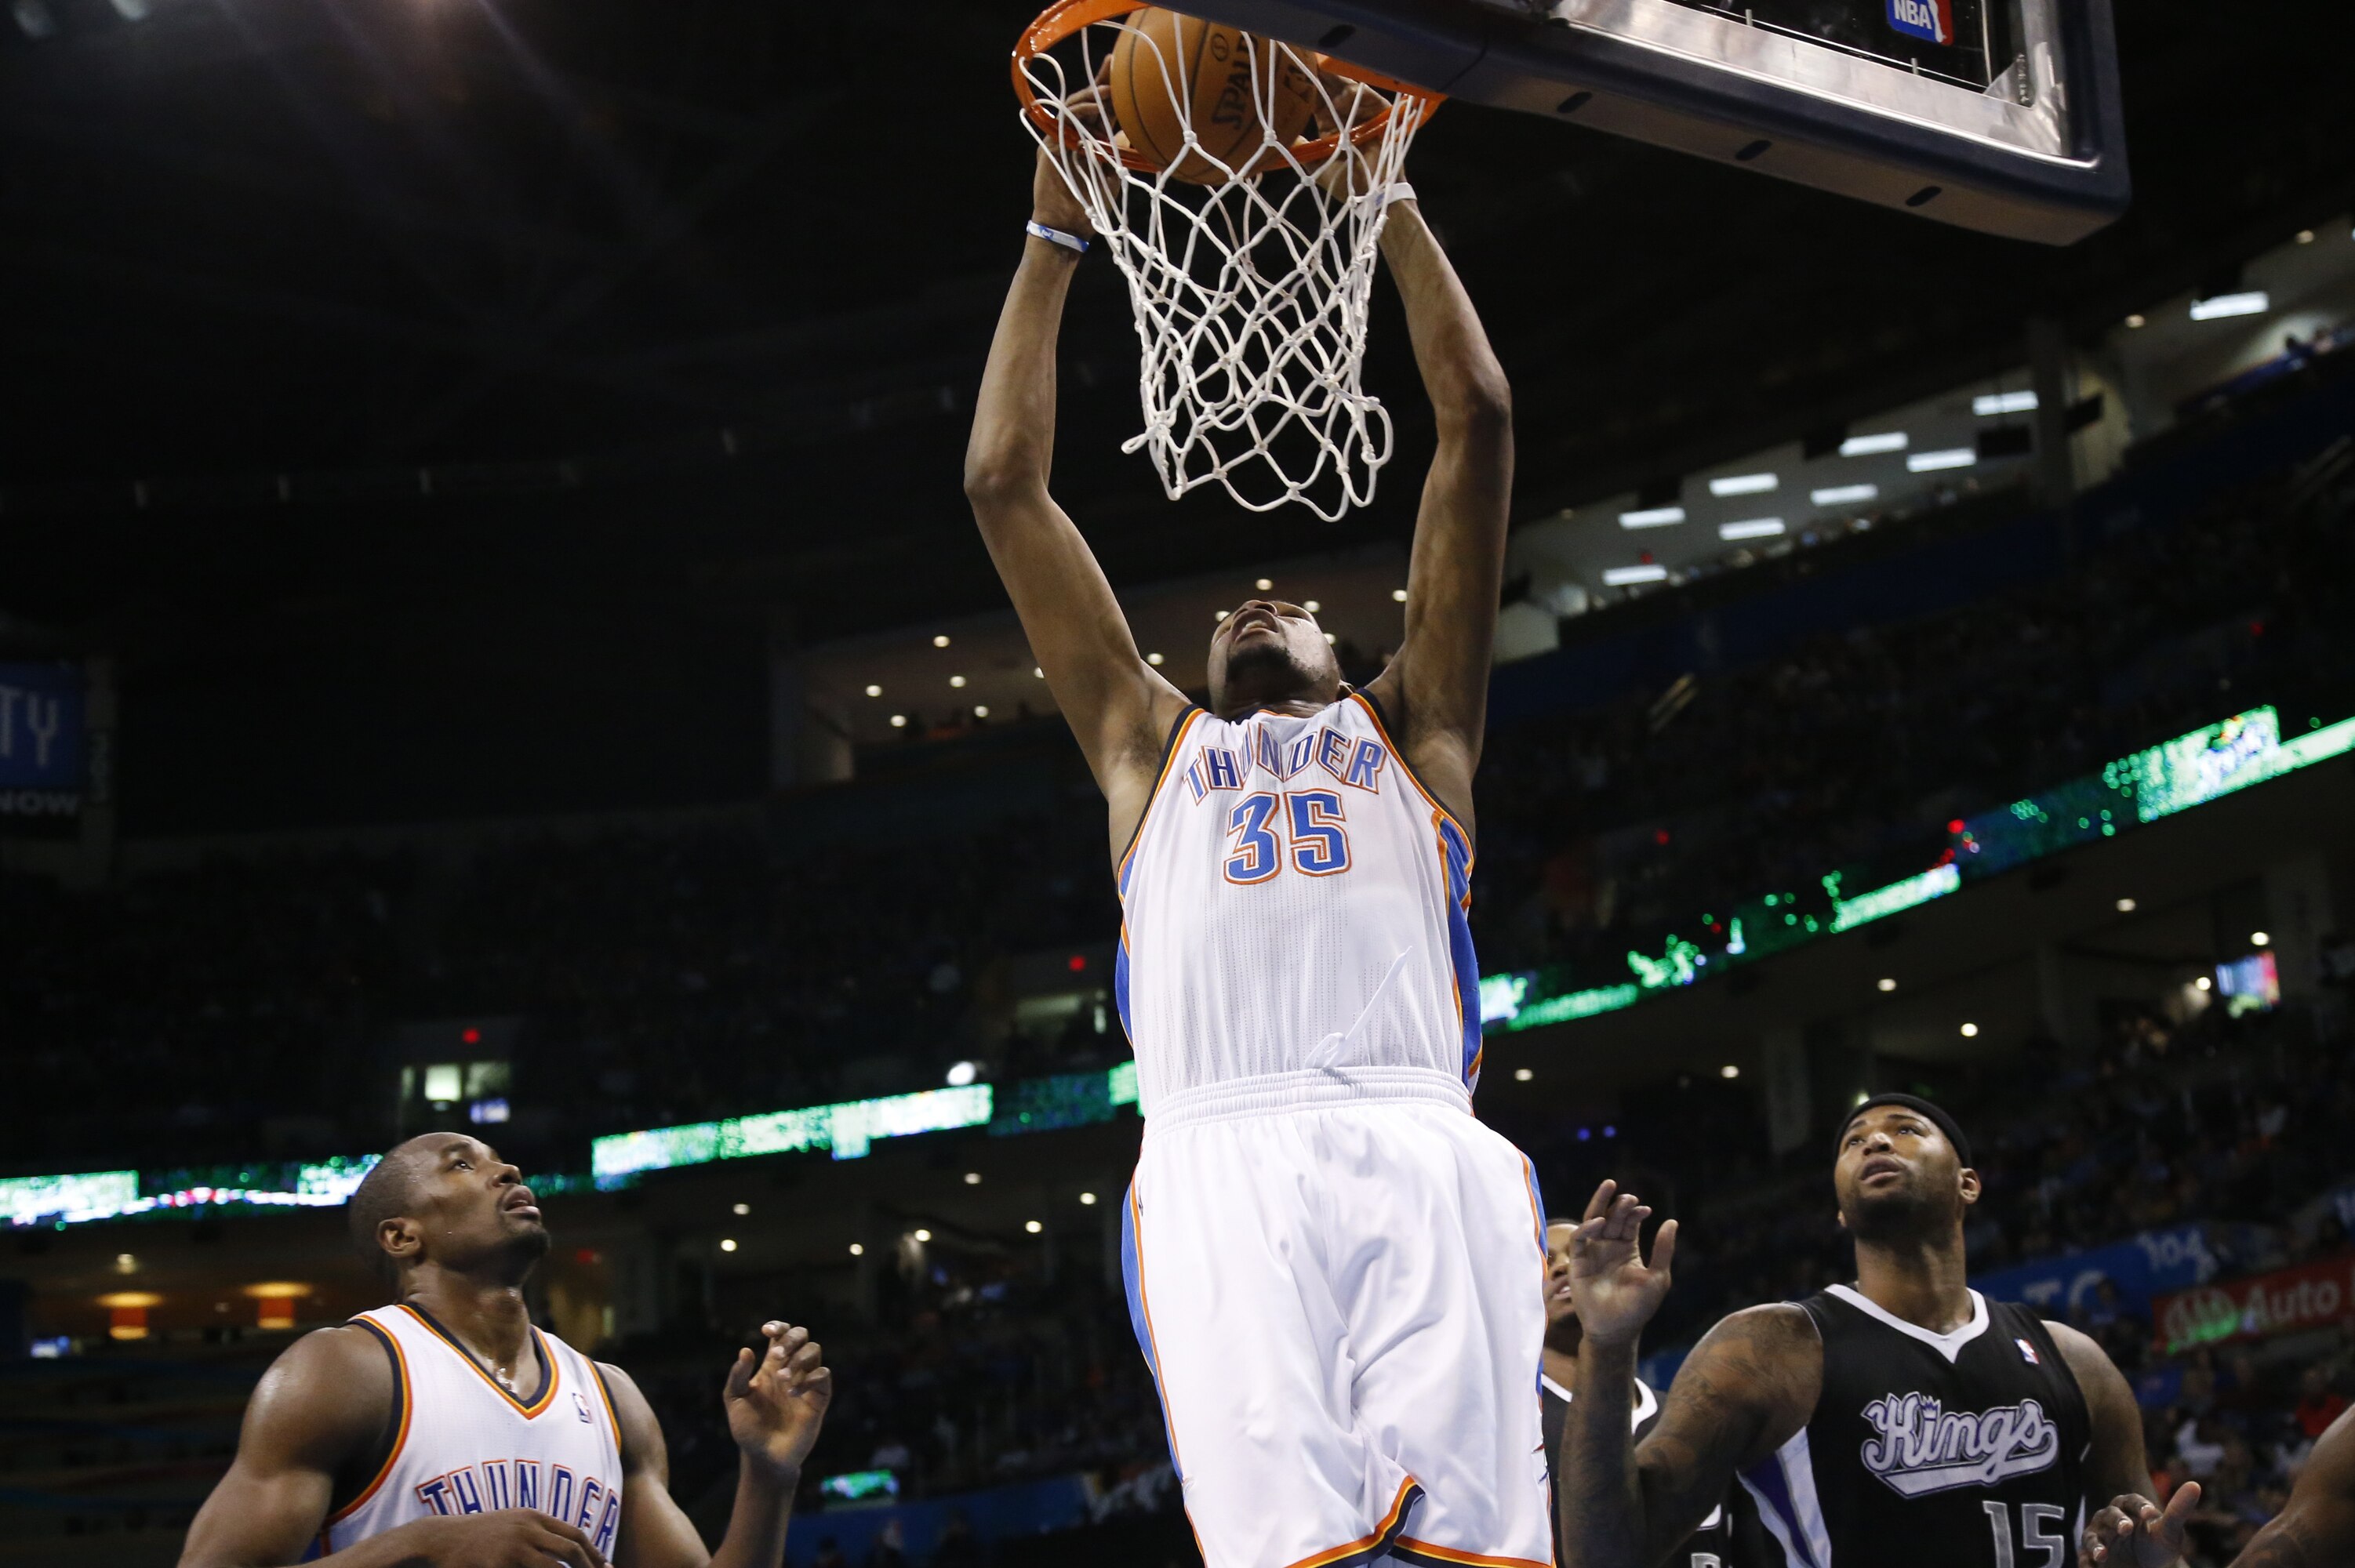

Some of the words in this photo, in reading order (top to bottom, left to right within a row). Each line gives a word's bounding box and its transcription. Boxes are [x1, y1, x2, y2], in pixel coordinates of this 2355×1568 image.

[1893, 0, 1933, 30] NBA
[1183, 721, 1386, 807] THUNDER
[1223, 787, 1352, 885] 35
[2244, 1279, 2341, 1328] Auto
[1860, 1391, 2059, 1499] Kings
[1982, 1500, 2066, 1568] 15
